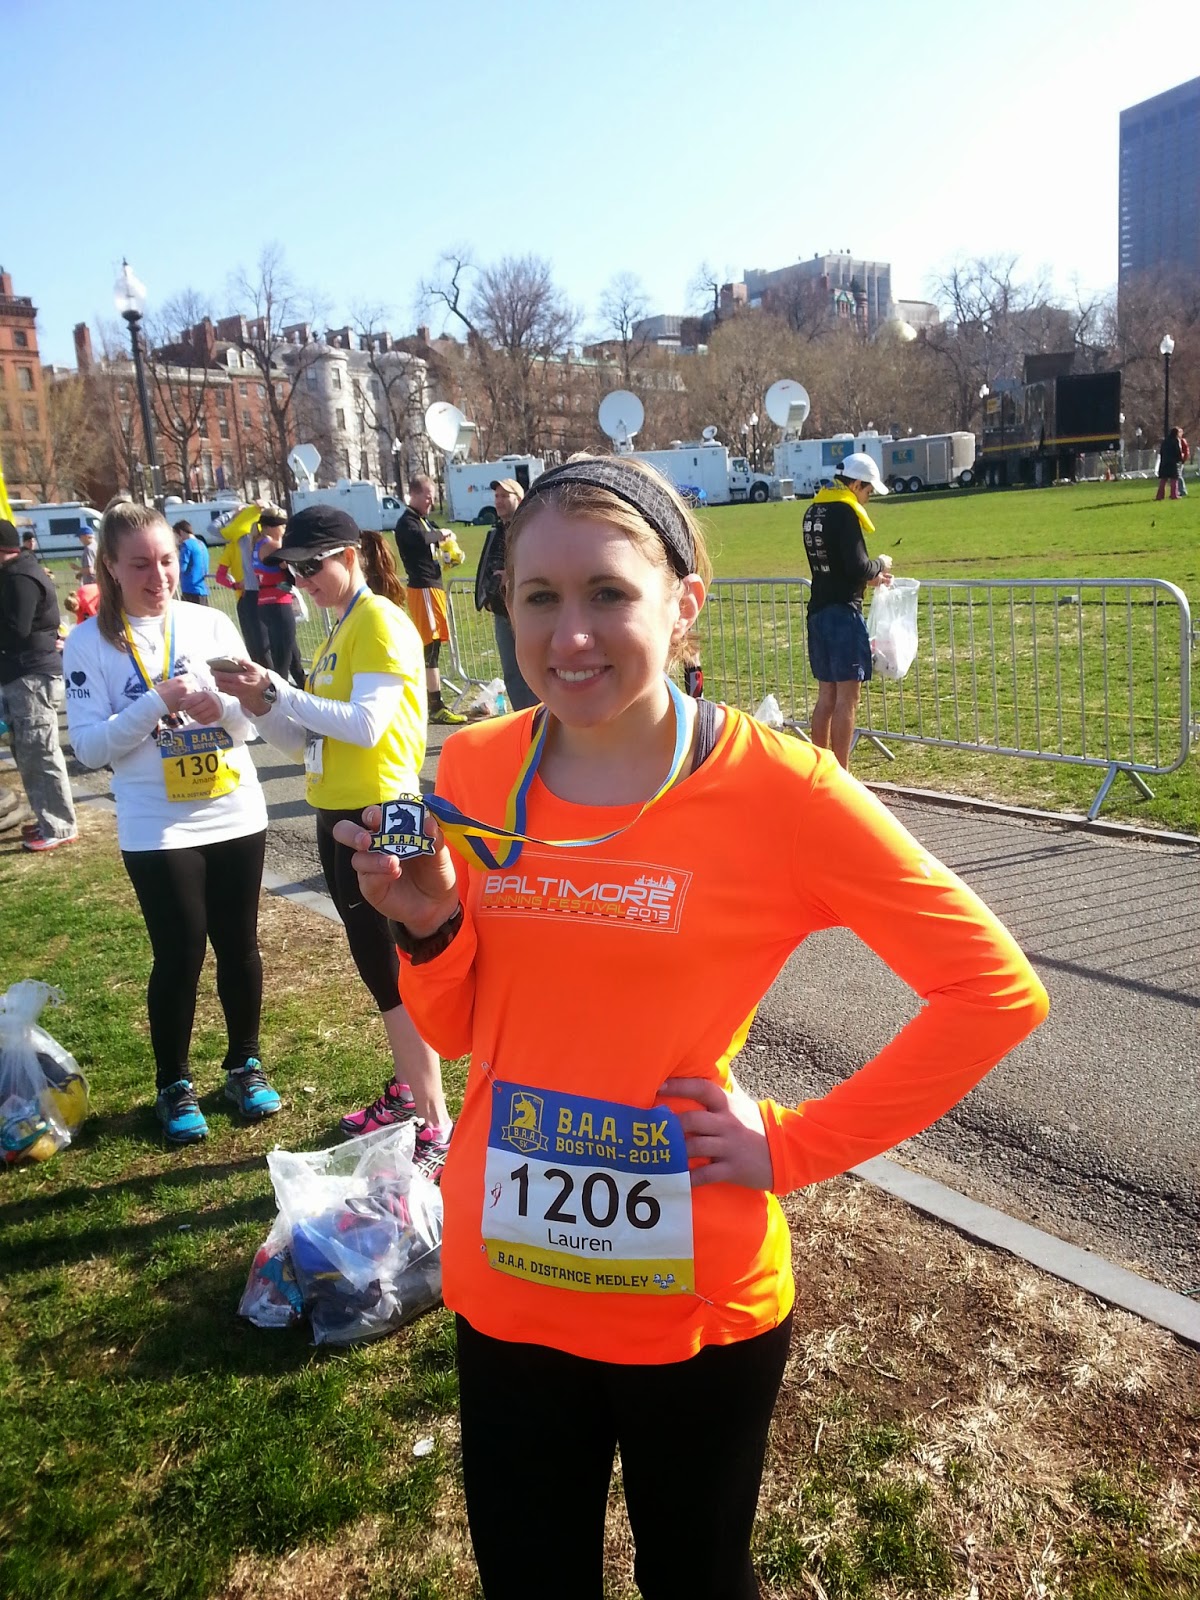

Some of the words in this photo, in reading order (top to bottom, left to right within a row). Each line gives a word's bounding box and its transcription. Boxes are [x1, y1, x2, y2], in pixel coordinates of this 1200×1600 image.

[66, 688, 91, 699] STON
[175, 753, 229, 777] 130
[388, 834, 418, 845] B.A.A.
[395, 845, 407, 853] 5K
[484, 875, 676, 910] BALTIMORE
[483, 894, 542, 906] RUNNING
[549, 897, 626, 915] FESTIVAL
[626, 906, 670, 921] 2013
[556, 1107, 624, 1144] B.A.A.
[632, 1120, 670, 1147] 5K
[519, 1140, 528, 1148] 5K
[510, 1162, 661, 1230] 1206
[547, 1228, 613, 1252] Lauren
[497, 1251, 527, 1271] B.A.A.
[530, 1263, 592, 1285] DISTANCE
[595, 1274, 649, 1287] MEDLEY
